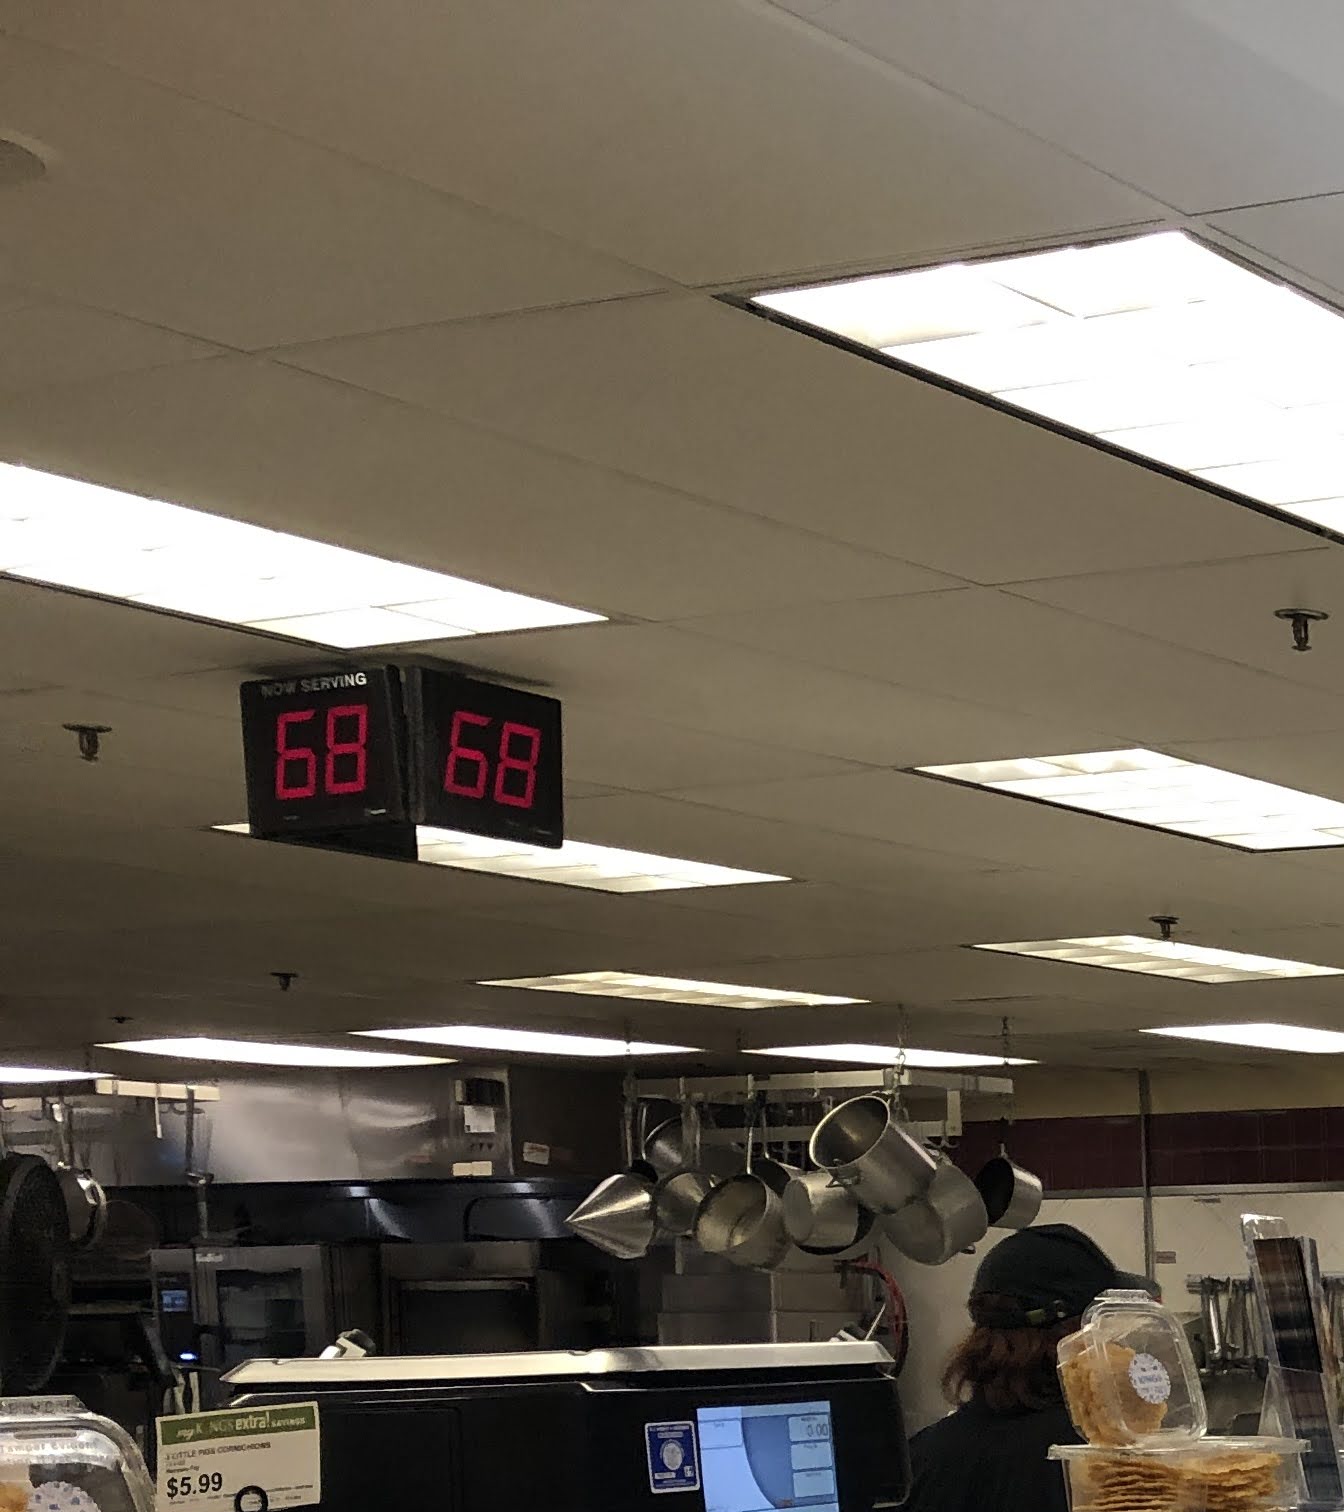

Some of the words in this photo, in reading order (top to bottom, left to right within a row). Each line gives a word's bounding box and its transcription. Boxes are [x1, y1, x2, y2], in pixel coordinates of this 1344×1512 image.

[261, 683, 296, 698] NOW
[300, 672, 368, 693] SERVING
[276, 704, 368, 800] 68
[444, 711, 541, 809] 68
[166, 1472, 222, 1499] $5.99
